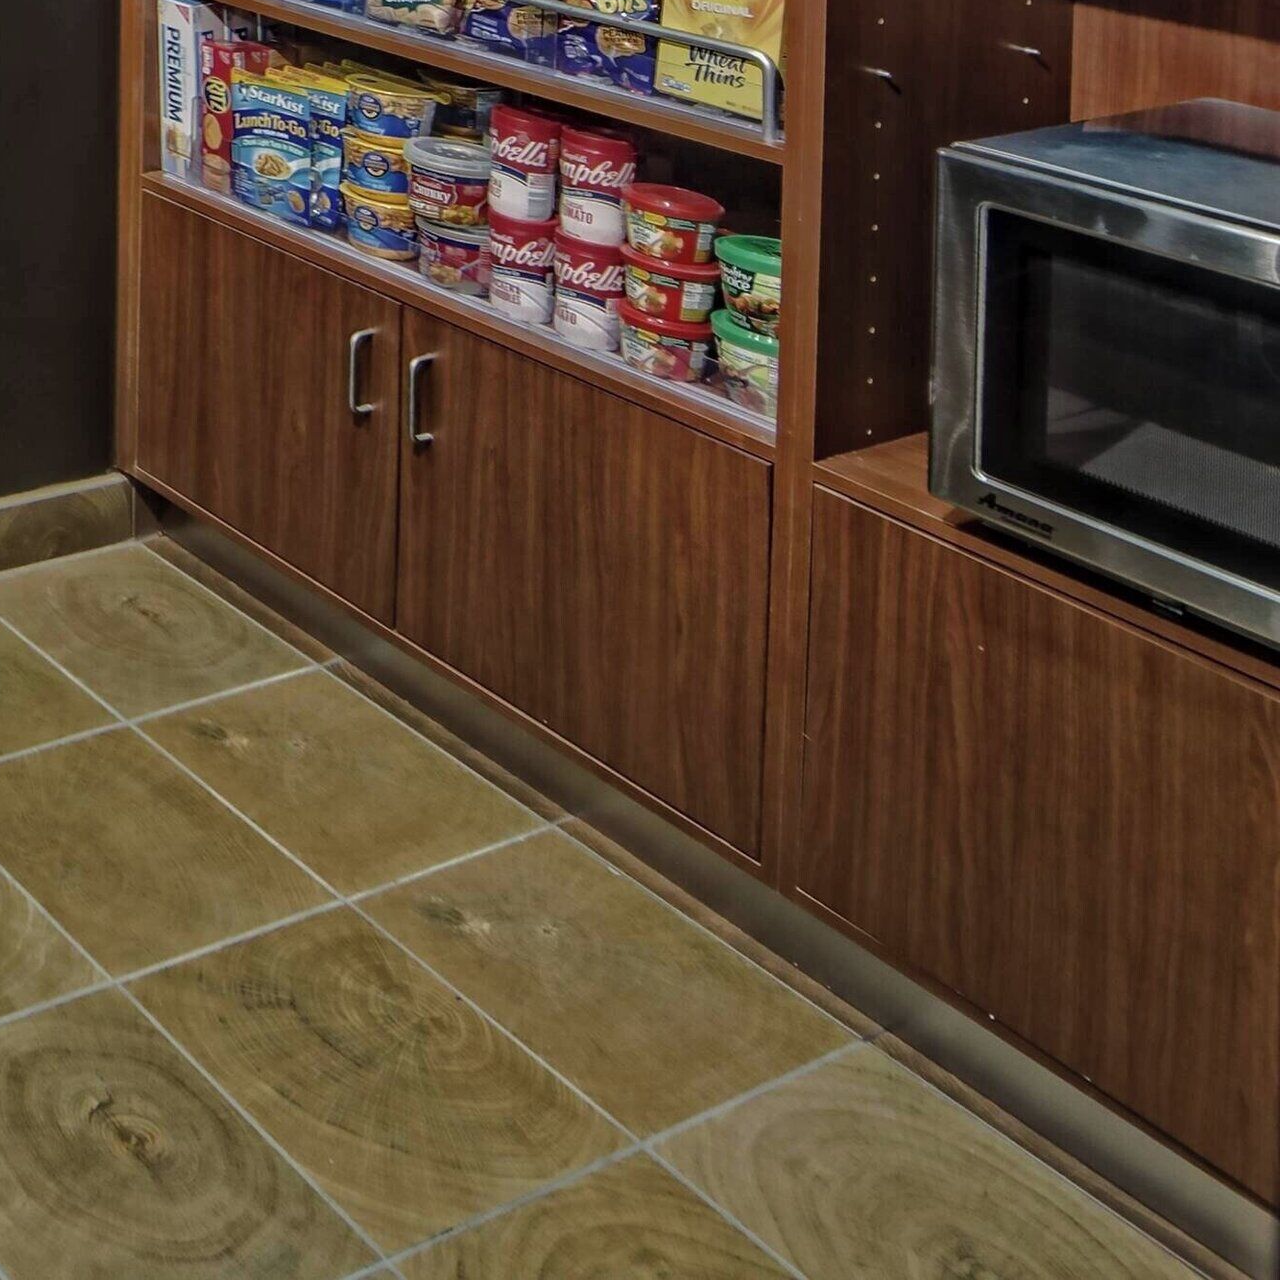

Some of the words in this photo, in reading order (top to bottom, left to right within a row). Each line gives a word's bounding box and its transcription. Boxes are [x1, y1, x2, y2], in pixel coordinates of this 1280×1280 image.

[687, 45, 745, 73] Wheat
[166, 26, 184, 123] PREMIUM
[685, 63, 746, 89] Thins
[248, 86, 304, 115] StarKist
